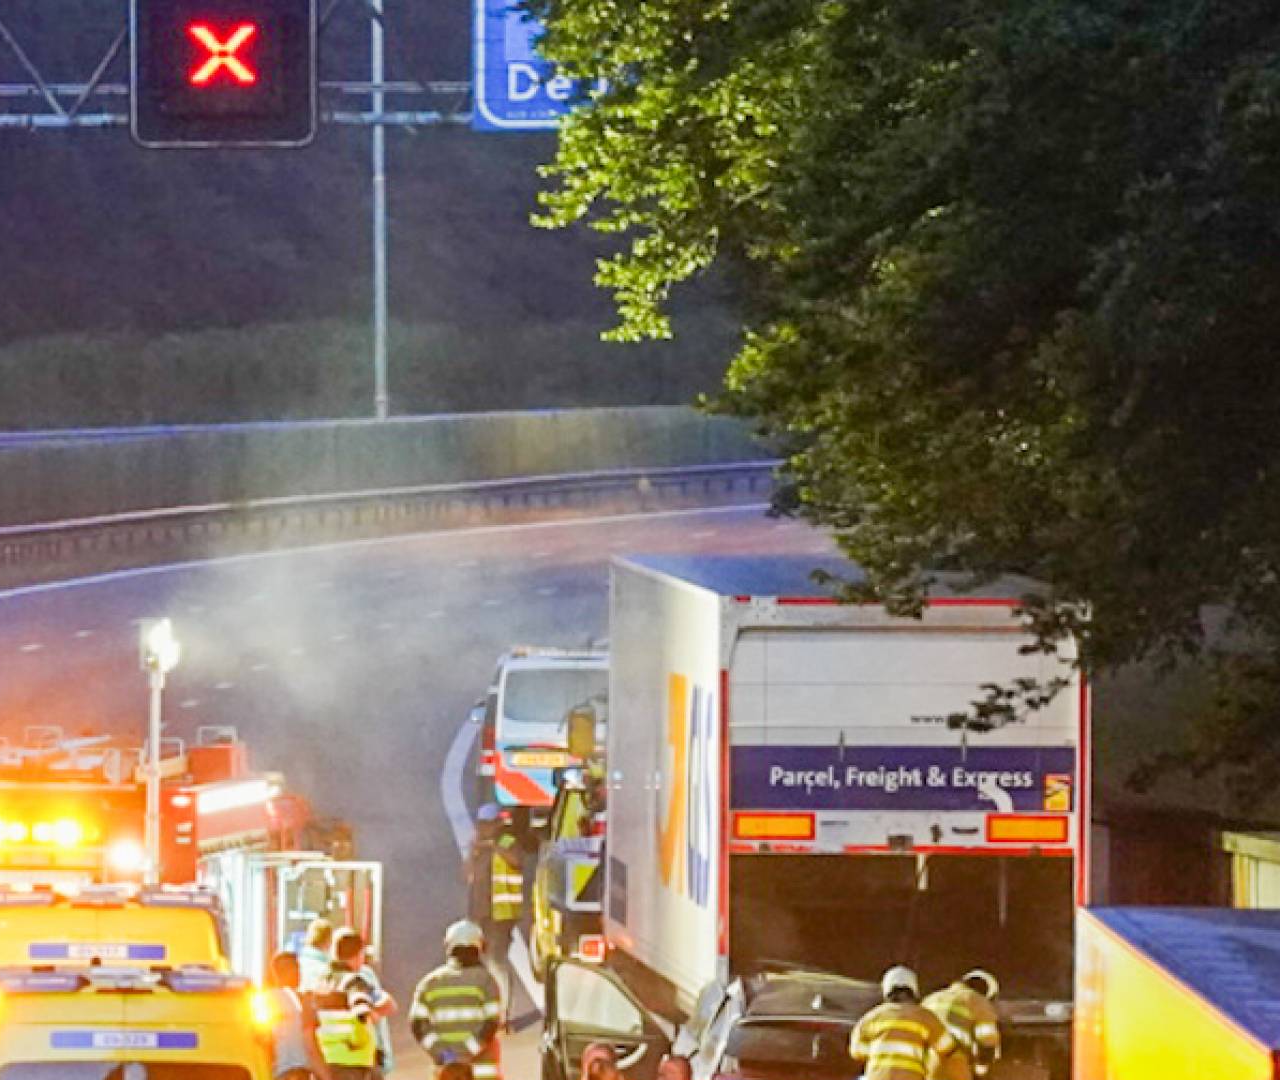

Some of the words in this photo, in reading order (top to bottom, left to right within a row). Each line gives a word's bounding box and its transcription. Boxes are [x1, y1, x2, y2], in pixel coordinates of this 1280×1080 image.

[770, 766, 841, 790] Parcel,
[846, 766, 923, 792] Freight
[927, 766, 946, 788] &
[951, 767, 1034, 795] Express
